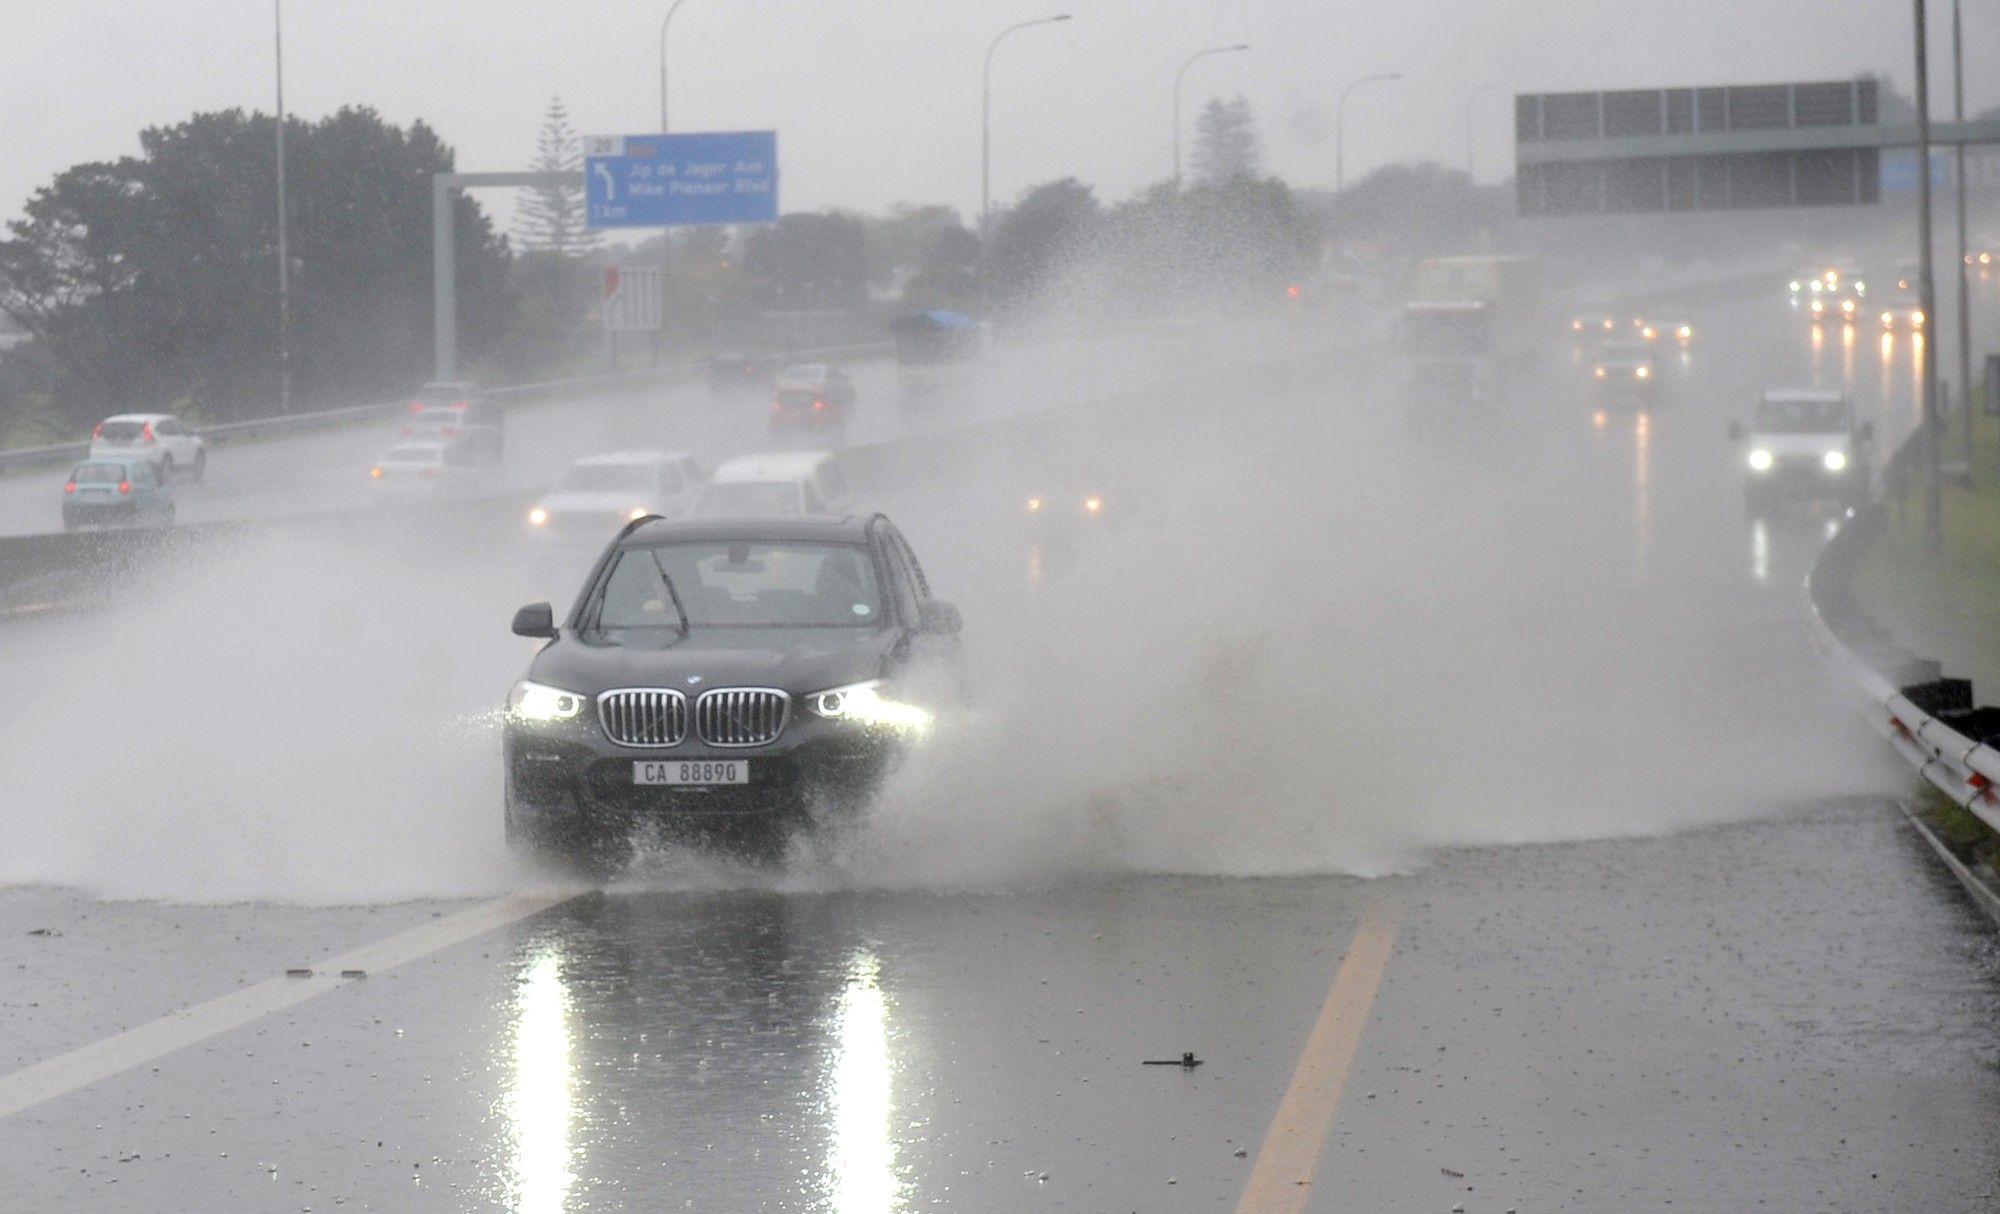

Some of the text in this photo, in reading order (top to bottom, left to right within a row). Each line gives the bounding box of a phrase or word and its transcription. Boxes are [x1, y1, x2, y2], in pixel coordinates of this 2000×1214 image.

[657, 163, 676, 176] de
[684, 162, 727, 178] Jager
[628, 182, 664, 196] Mike
[645, 763, 736, 782] CA 88890
